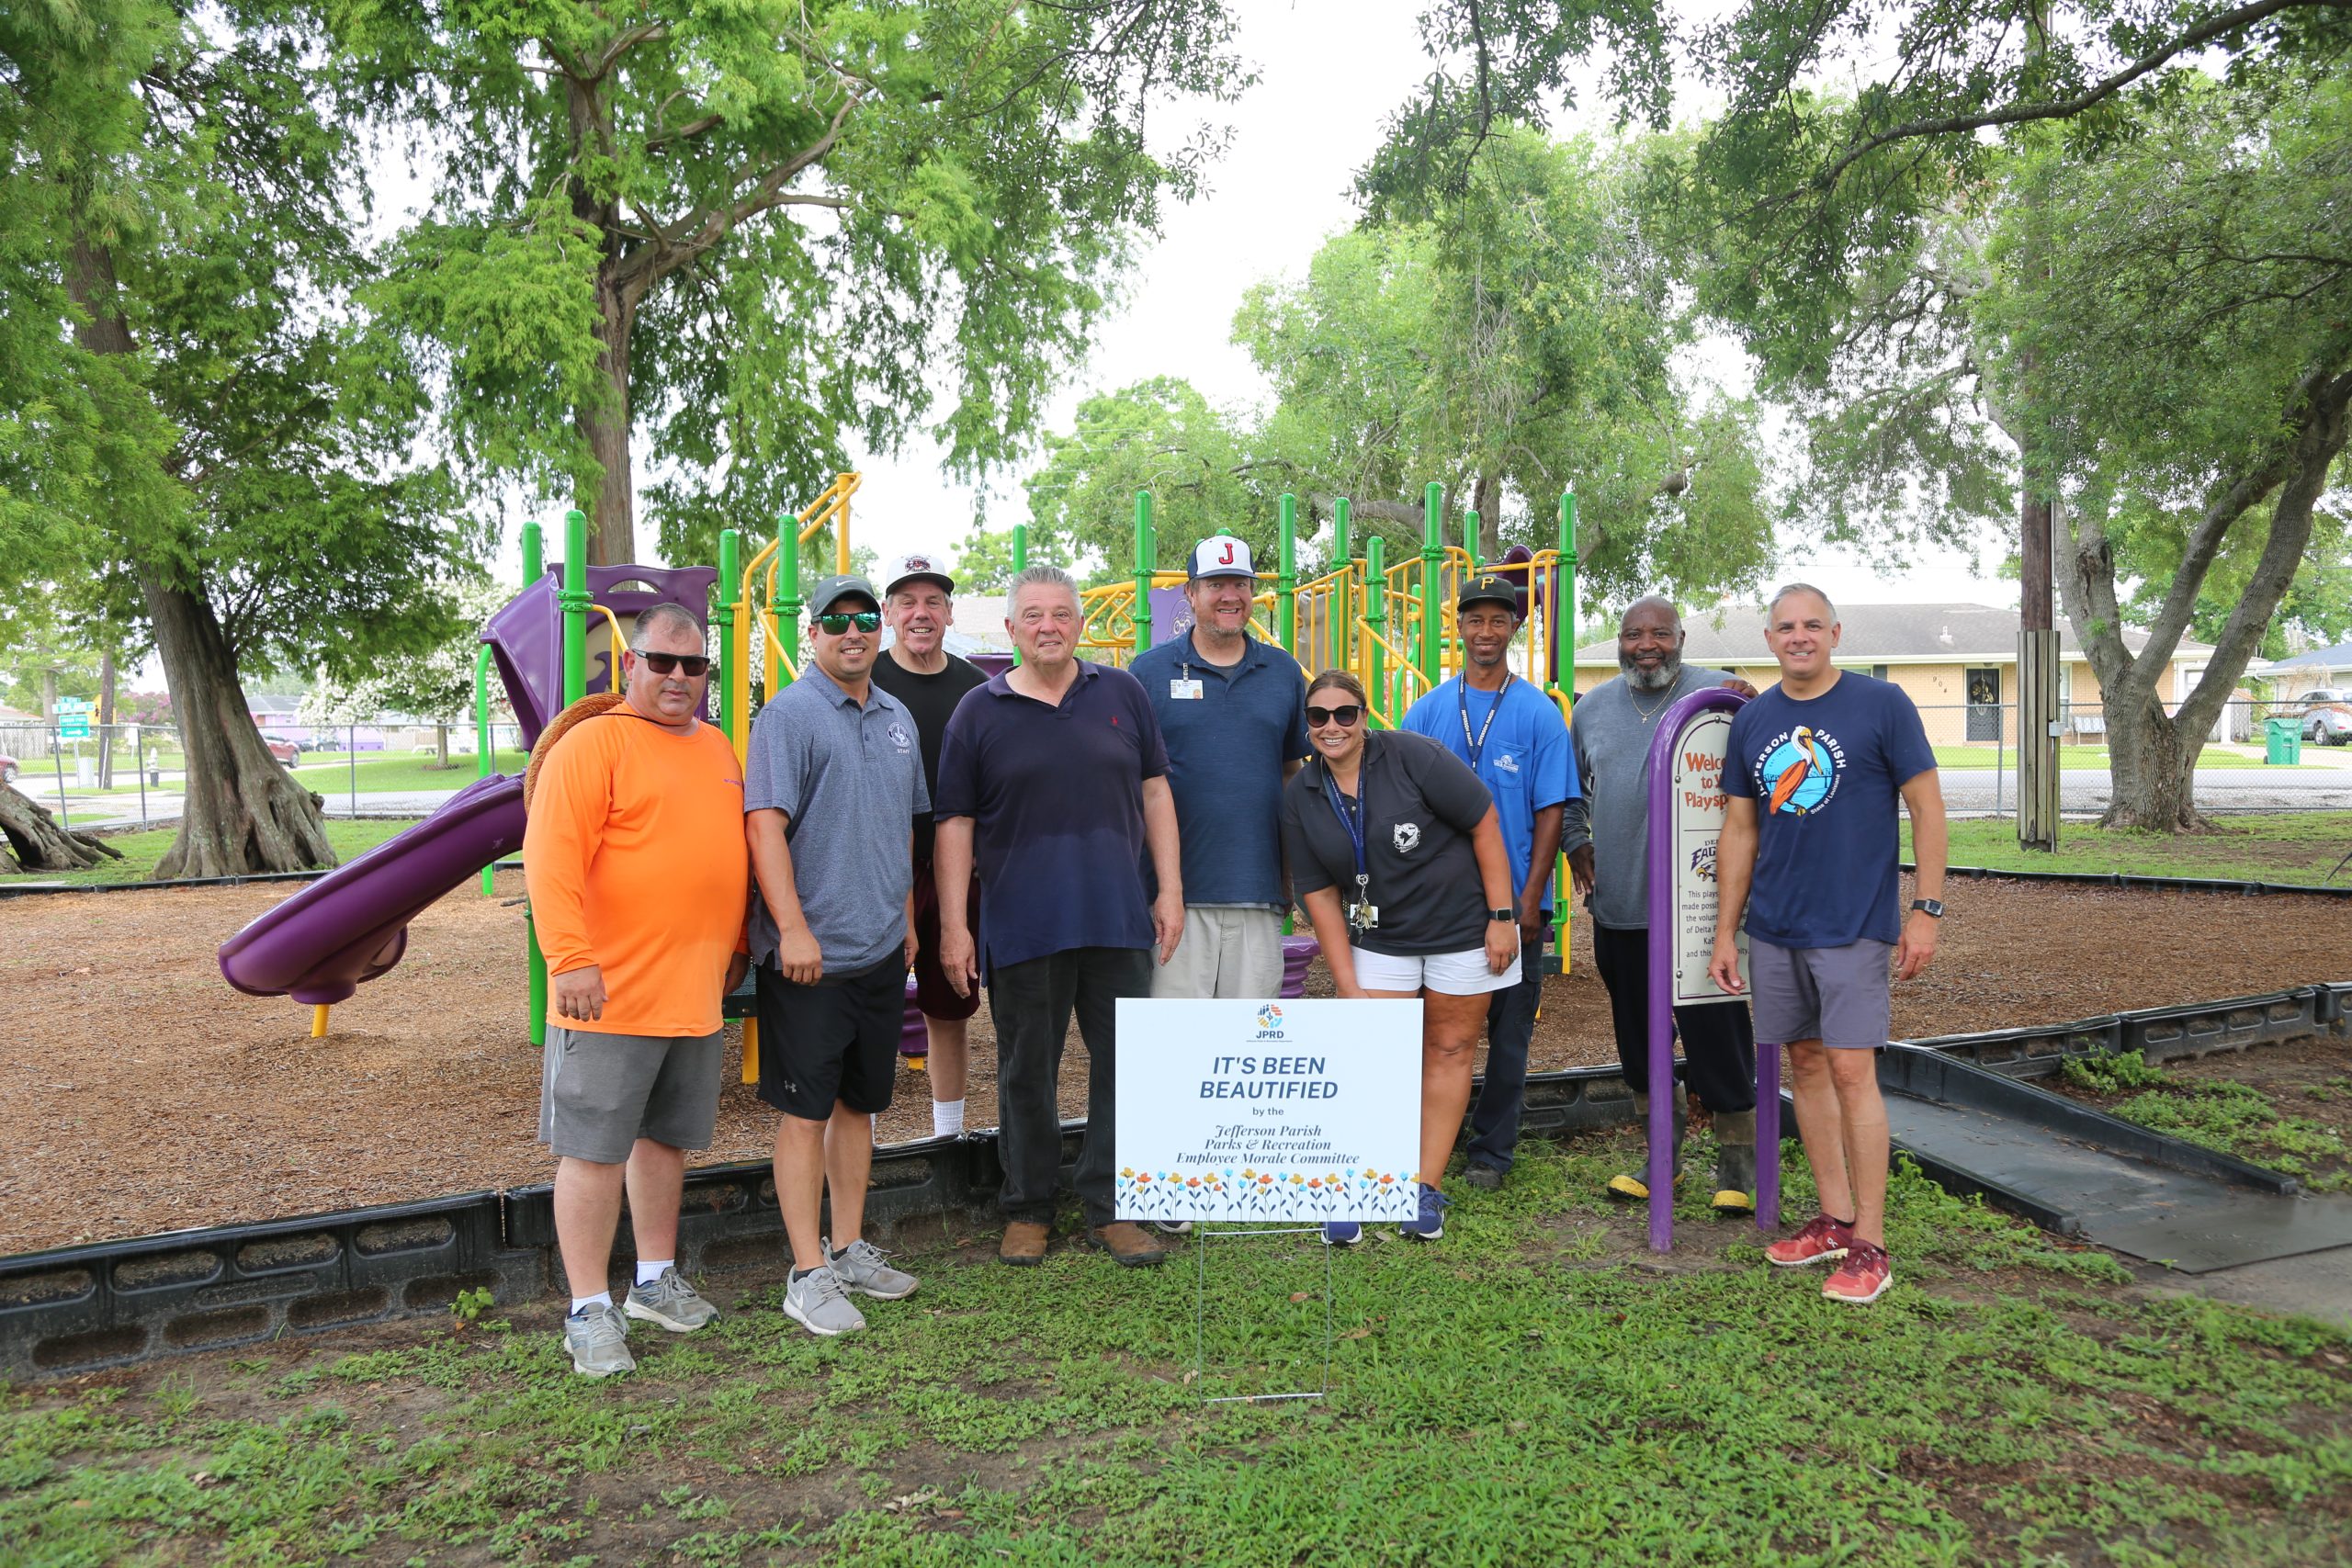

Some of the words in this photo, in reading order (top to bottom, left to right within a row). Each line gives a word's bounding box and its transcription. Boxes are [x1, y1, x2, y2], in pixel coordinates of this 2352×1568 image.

[1218, 543, 1233, 565] J
[1481, 576, 1495, 591] P
[1815, 729, 1847, 769] PARISH
[1684, 751, 1727, 773] Welco
[1701, 775, 1713, 789] to
[1684, 791, 1728, 812] Playsp
[1810, 803, 1826, 815] State
[1824, 796, 1830, 805] of
[1828, 773, 1841, 799] Louisiana
[1690, 846, 1717, 873] EAG
[1688, 890, 1702, 898] This
[1702, 890, 1719, 899] plays
[1681, 902, 1700, 910] made
[1701, 901, 1719, 911] possi
[1686, 926, 1694, 934] of
[1695, 925, 1712, 933] Delta
[1686, 949, 1699, 957] and
[1700, 949, 1712, 957] this
[1256, 1031, 1284, 1039] JPRD
[1213, 1057, 1256, 1075] IT'S
[1262, 1057, 1325, 1075] BEEN
[1199, 1081, 1338, 1099] BEAUTIFIED
[1252, 1107, 1265, 1117] by
[1267, 1107, 1283, 1116] the
[1215, 1124, 1275, 1139] Jefferson
[1279, 1124, 1322, 1136] Parish
[1204, 1138, 1242, 1150] Parks
[1245, 1139, 1259, 1150] &
[1261, 1138, 1331, 1150] Recreation
[1176, 1152, 1238, 1166] Employee
[1240, 1152, 1287, 1164] Morale
[1290, 1152, 1360, 1164] Committee
